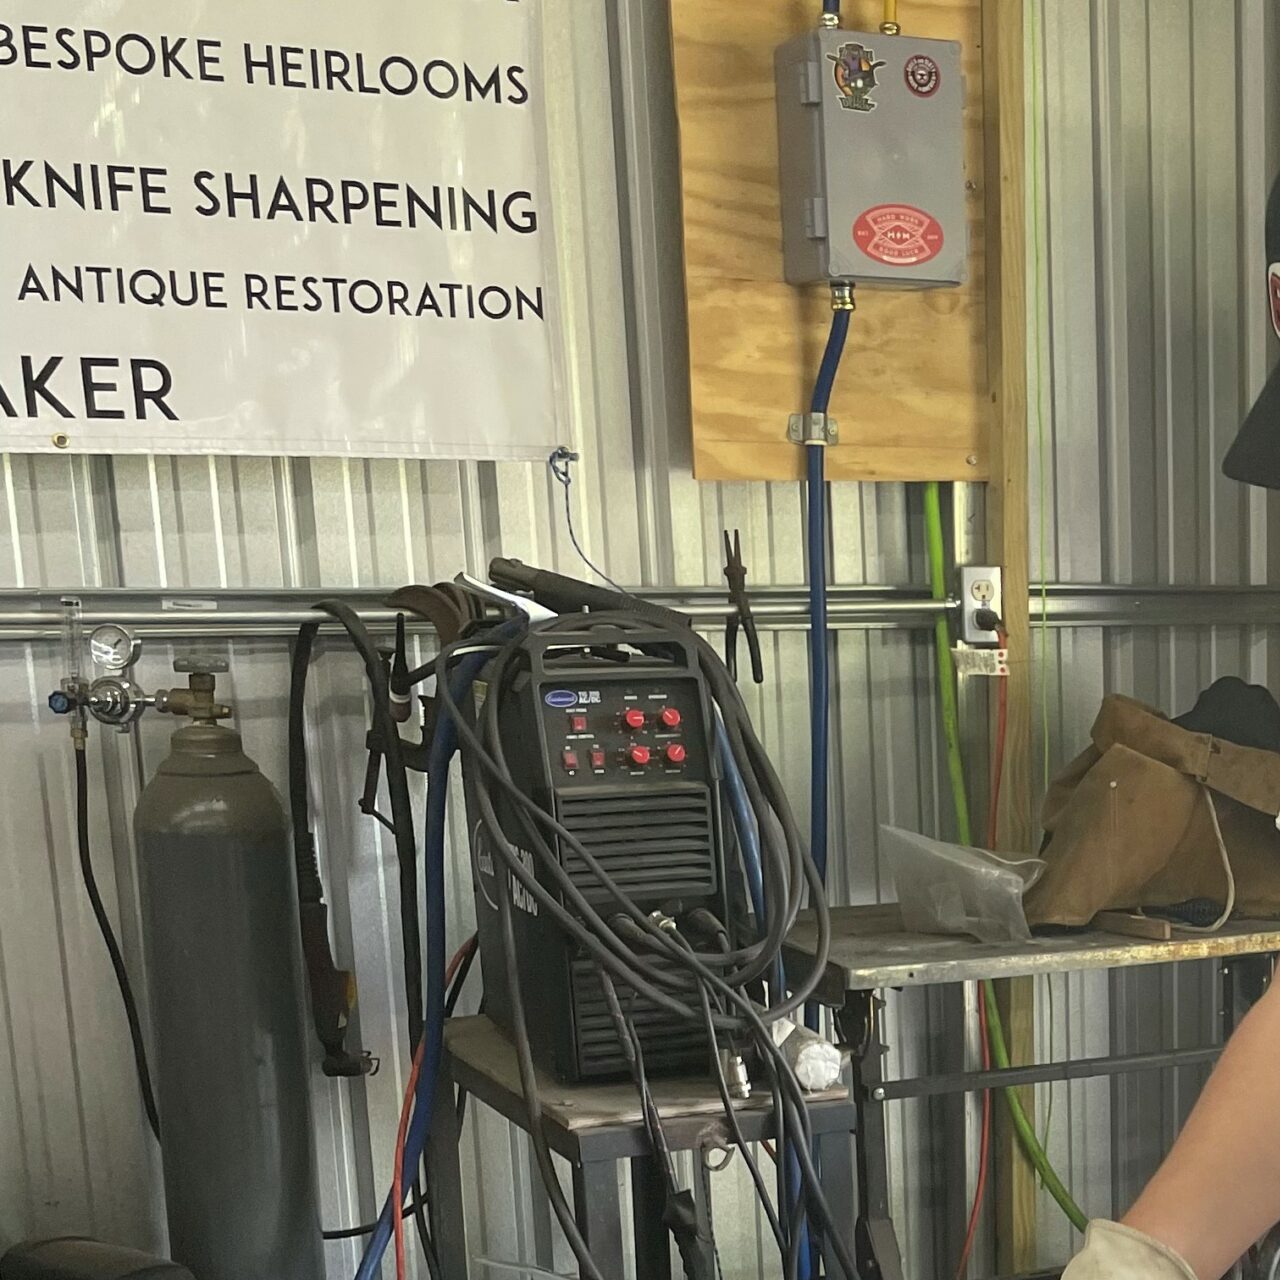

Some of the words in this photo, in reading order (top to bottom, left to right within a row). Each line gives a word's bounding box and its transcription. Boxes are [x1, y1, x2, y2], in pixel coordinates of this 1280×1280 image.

[243, 43, 529, 105] HEIRLOOMS
[2, 159, 171, 214] KNIFE
[193, 171, 537, 234] SHARPENING
[18, 263, 228, 309] ANTIQUE
[245, 273, 544, 321] RESTORATION
